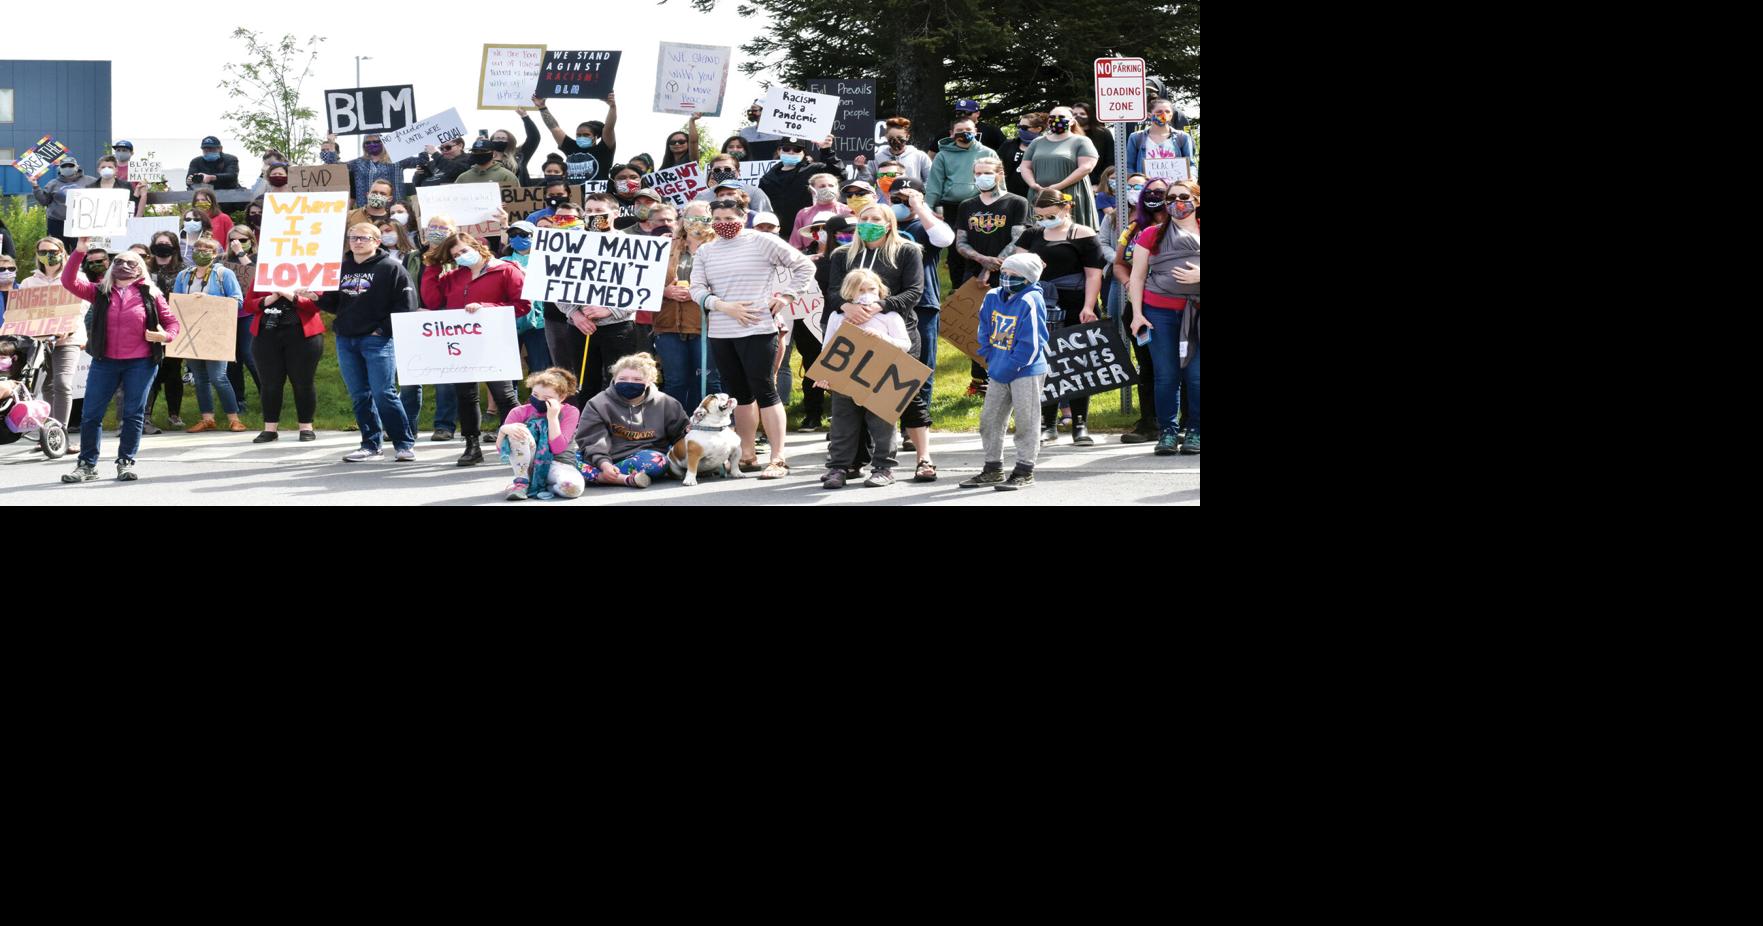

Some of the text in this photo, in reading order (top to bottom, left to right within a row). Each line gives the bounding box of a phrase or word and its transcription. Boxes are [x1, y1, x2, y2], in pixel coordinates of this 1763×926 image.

[553, 51, 611, 60] WE STAND
[546, 62, 601, 71] AGINST
[1097, 63, 1142, 75] NO PARKING
[782, 91, 817, 105] Racism
[1101, 87, 1141, 97] LOADING
[327, 87, 413, 134] BLM
[788, 102, 806, 113] is a
[843, 108, 869, 120] people
[1109, 102, 1134, 111] ZONE
[773, 109, 817, 124] Pandemic
[437, 126, 464, 144] EQUAL
[812, 136, 875, 152] NTHING
[20, 141, 63, 174] BREATHE
[300, 169, 331, 187] END
[675, 163, 698, 180] NOT
[268, 194, 346, 214] Where
[501, 188, 543, 203] BLAC
[271, 237, 319, 256] The
[536, 230, 669, 262] HOW MANY
[256, 262, 341, 288] LOVE
[545, 255, 648, 286] WEREN'T
[544, 279, 651, 309] FILMED?
[422, 321, 482, 337] Silence
[1043, 327, 1109, 357] LACK
[1046, 347, 1115, 378] LIVES
[821, 336, 920, 413] BLM
[1039, 363, 1130, 402] MATTER
